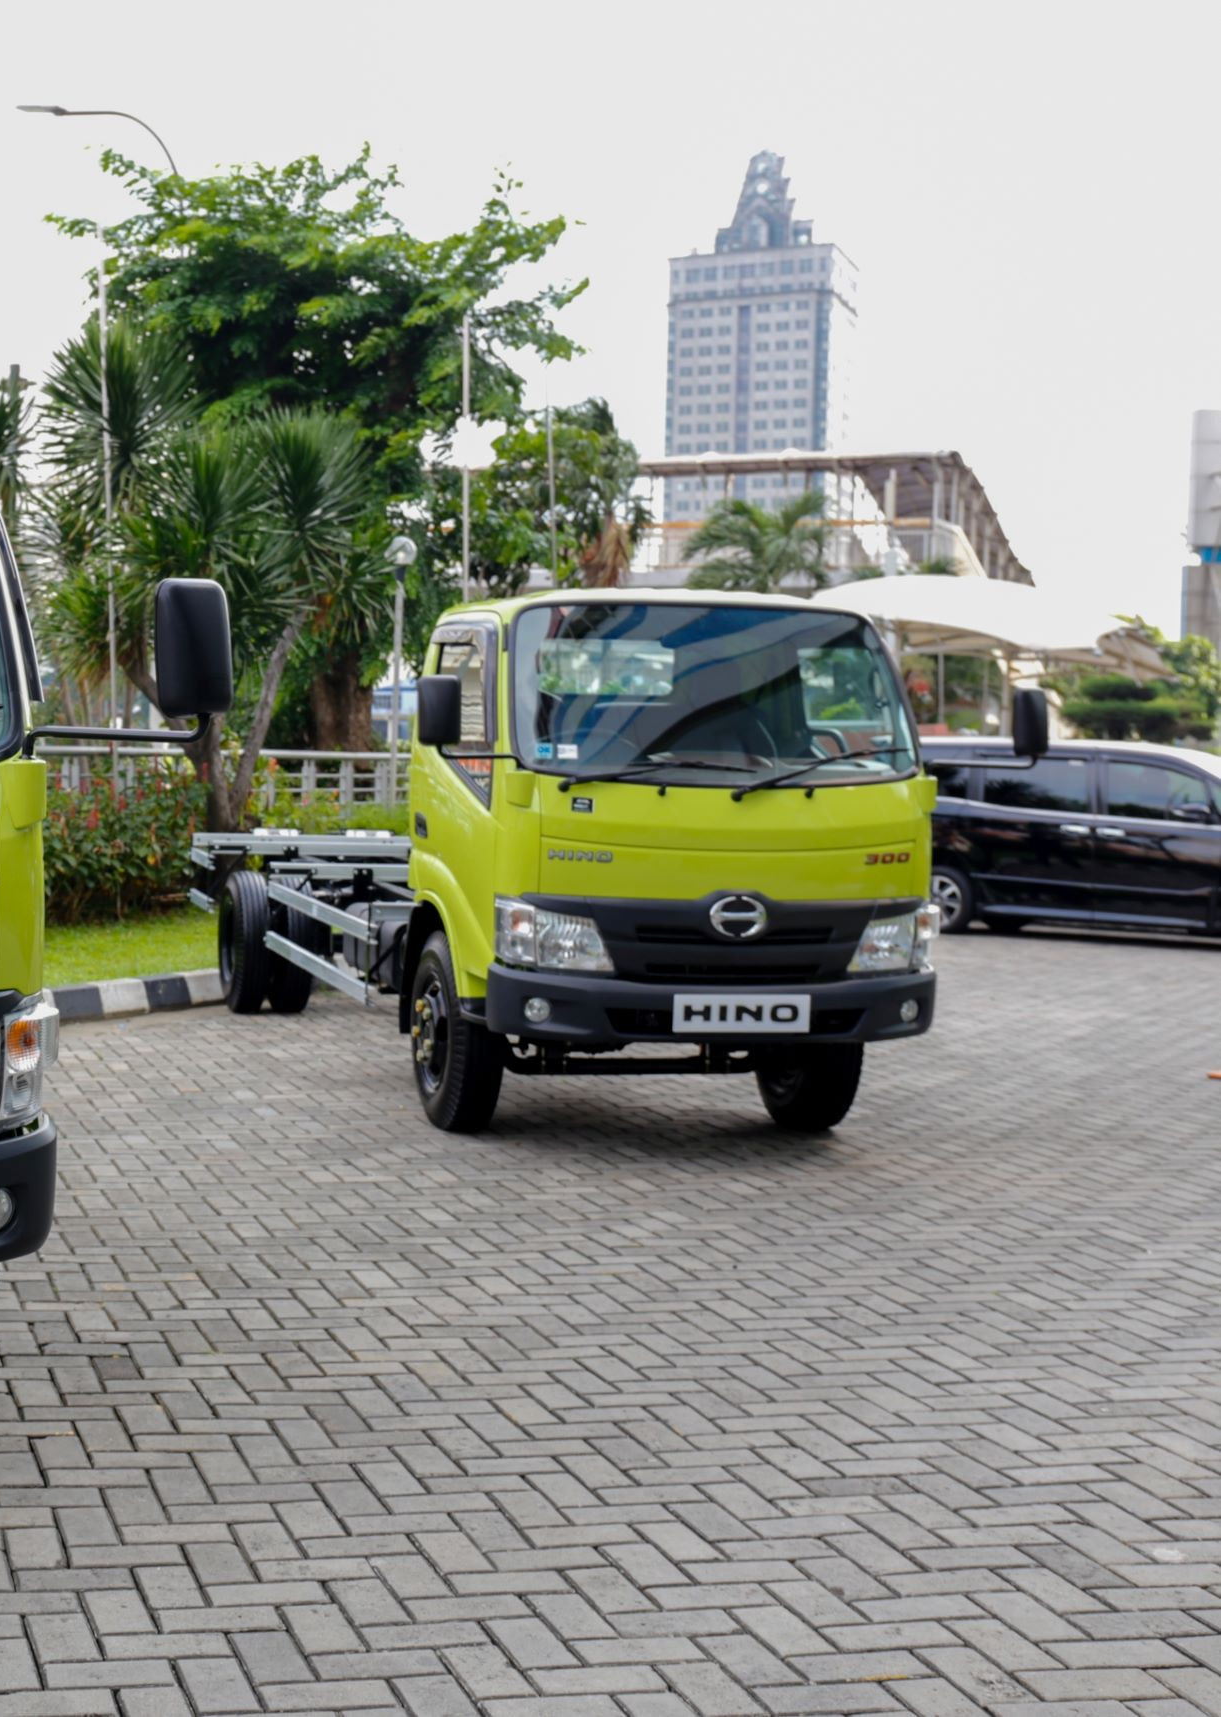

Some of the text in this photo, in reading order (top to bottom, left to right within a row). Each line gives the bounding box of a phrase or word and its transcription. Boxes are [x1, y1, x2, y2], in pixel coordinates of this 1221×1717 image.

[547, 848, 614, 863] HINO
[864, 852, 910, 866] 300
[683, 1004, 799, 1022] HINO
